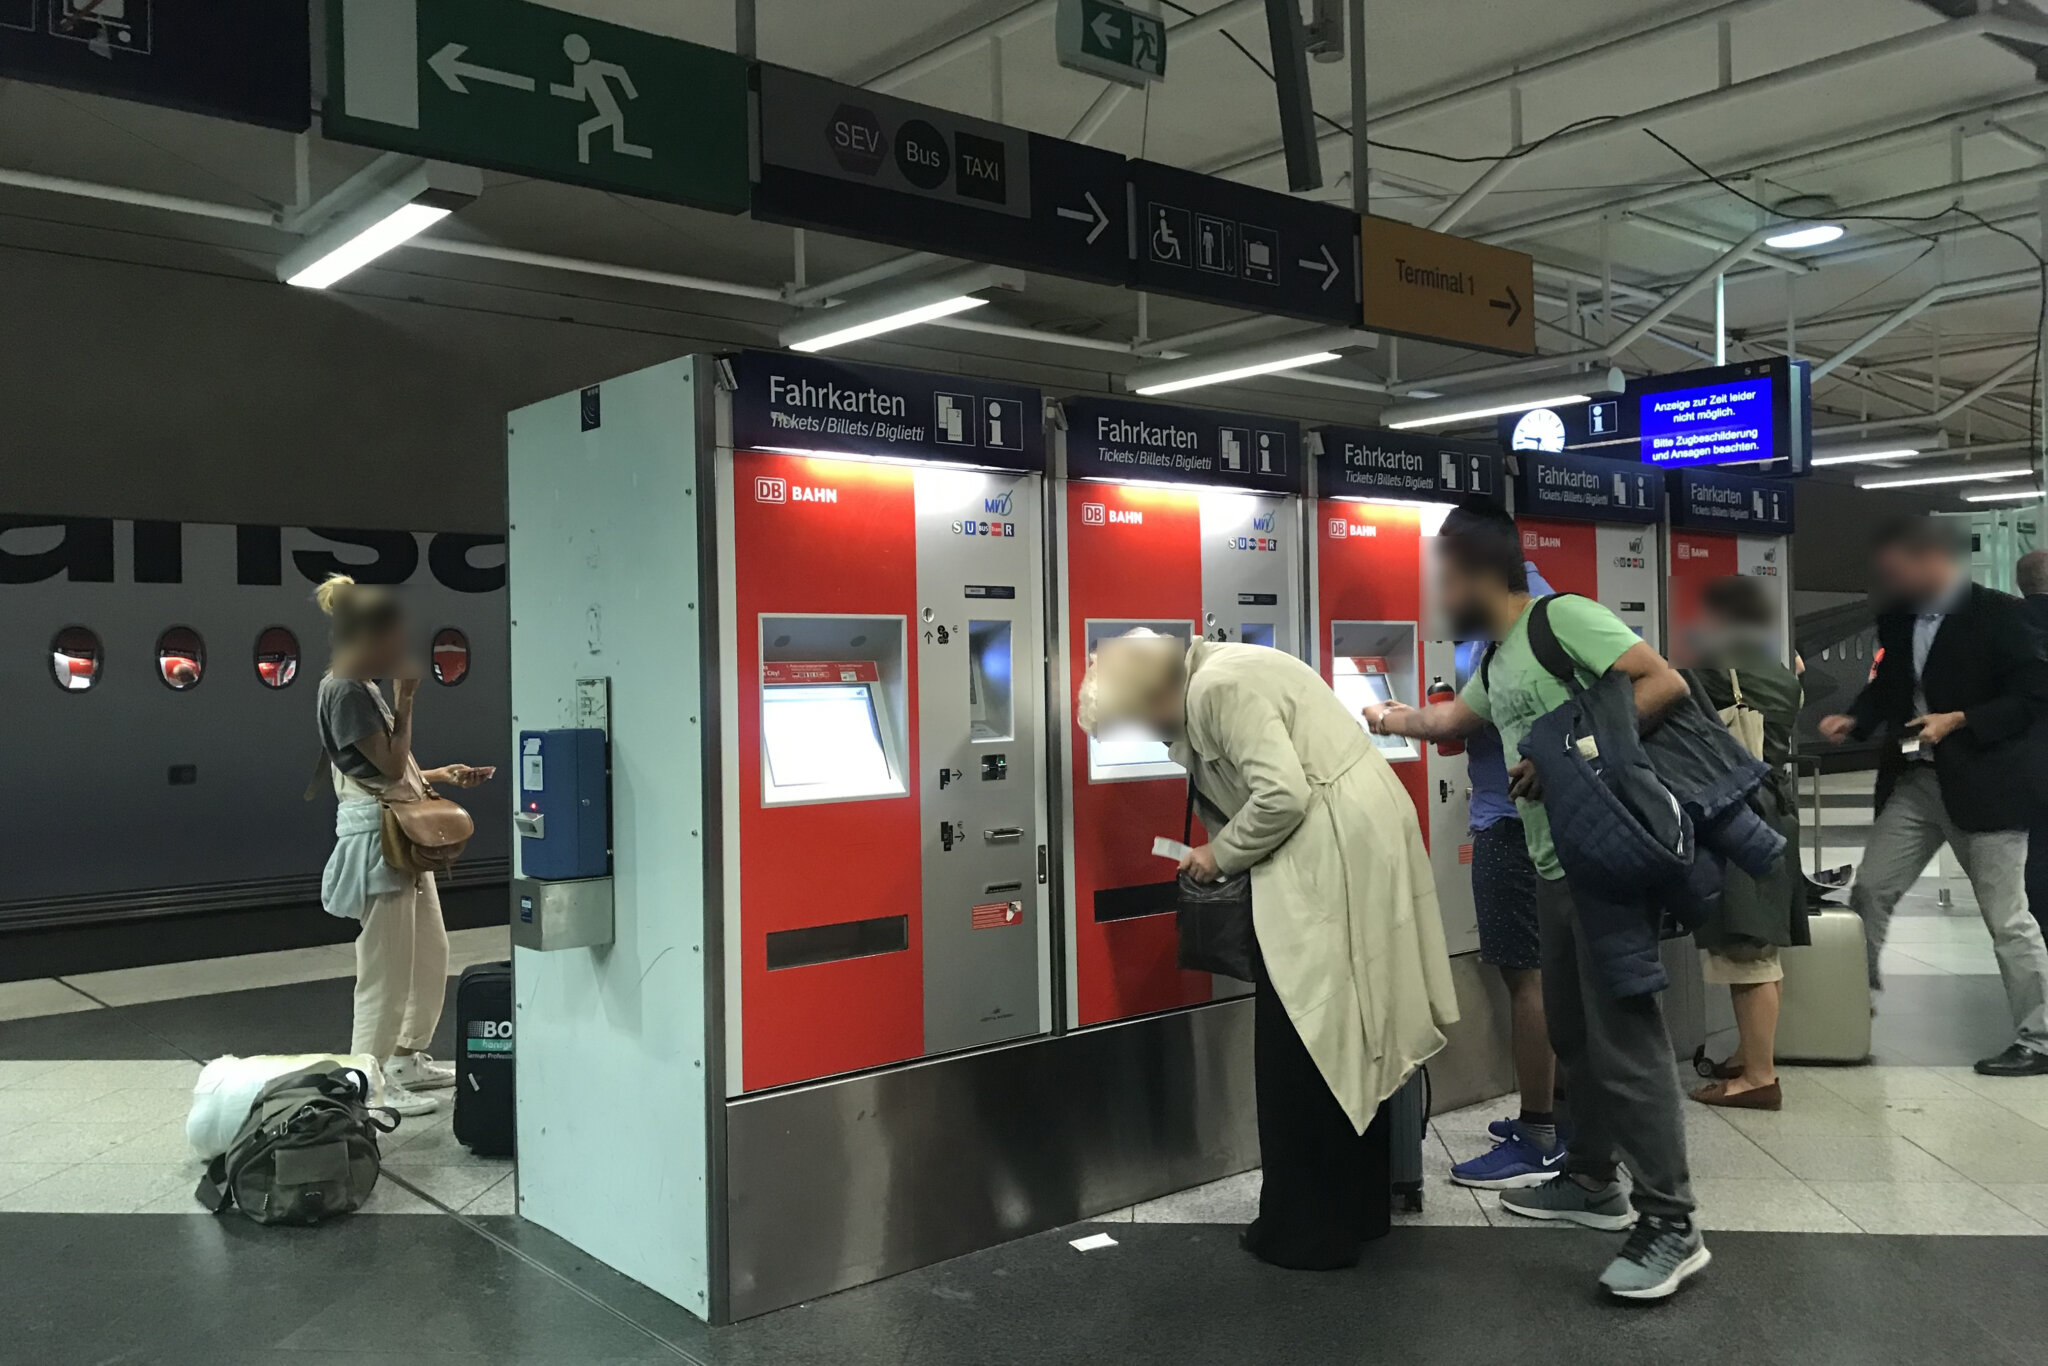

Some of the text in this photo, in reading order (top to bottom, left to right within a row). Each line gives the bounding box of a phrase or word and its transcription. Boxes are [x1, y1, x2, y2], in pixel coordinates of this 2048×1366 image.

[834, 121, 880, 153] SEV
[906, 141, 940, 168] Bus
[963, 154, 1000, 181] TAXI
[1395, 257, 1475, 296] Terminal 1
[770, 375, 906, 417] Fahrkarten
[1654, 390, 1756, 412] Anzeige zur Zeit leider
[1673, 407, 1735, 423] nicht möglich.
[1097, 416, 1198, 449] Fahrkarten
[1653, 429, 1758, 448] Bitte Zugbeschilderung
[1345, 443, 1423, 471] Fahrkarten
[1652, 442, 1759, 461] und Ansagen beachten.
[1537, 464, 1600, 489] Fahrkarten
[758, 480, 838, 503] DB BAHN
[1691, 482, 1742, 505] Fahrkarten
[1083, 504, 1143, 524] DB BAHN
[1330, 520, 1377, 537] DB BAHN
